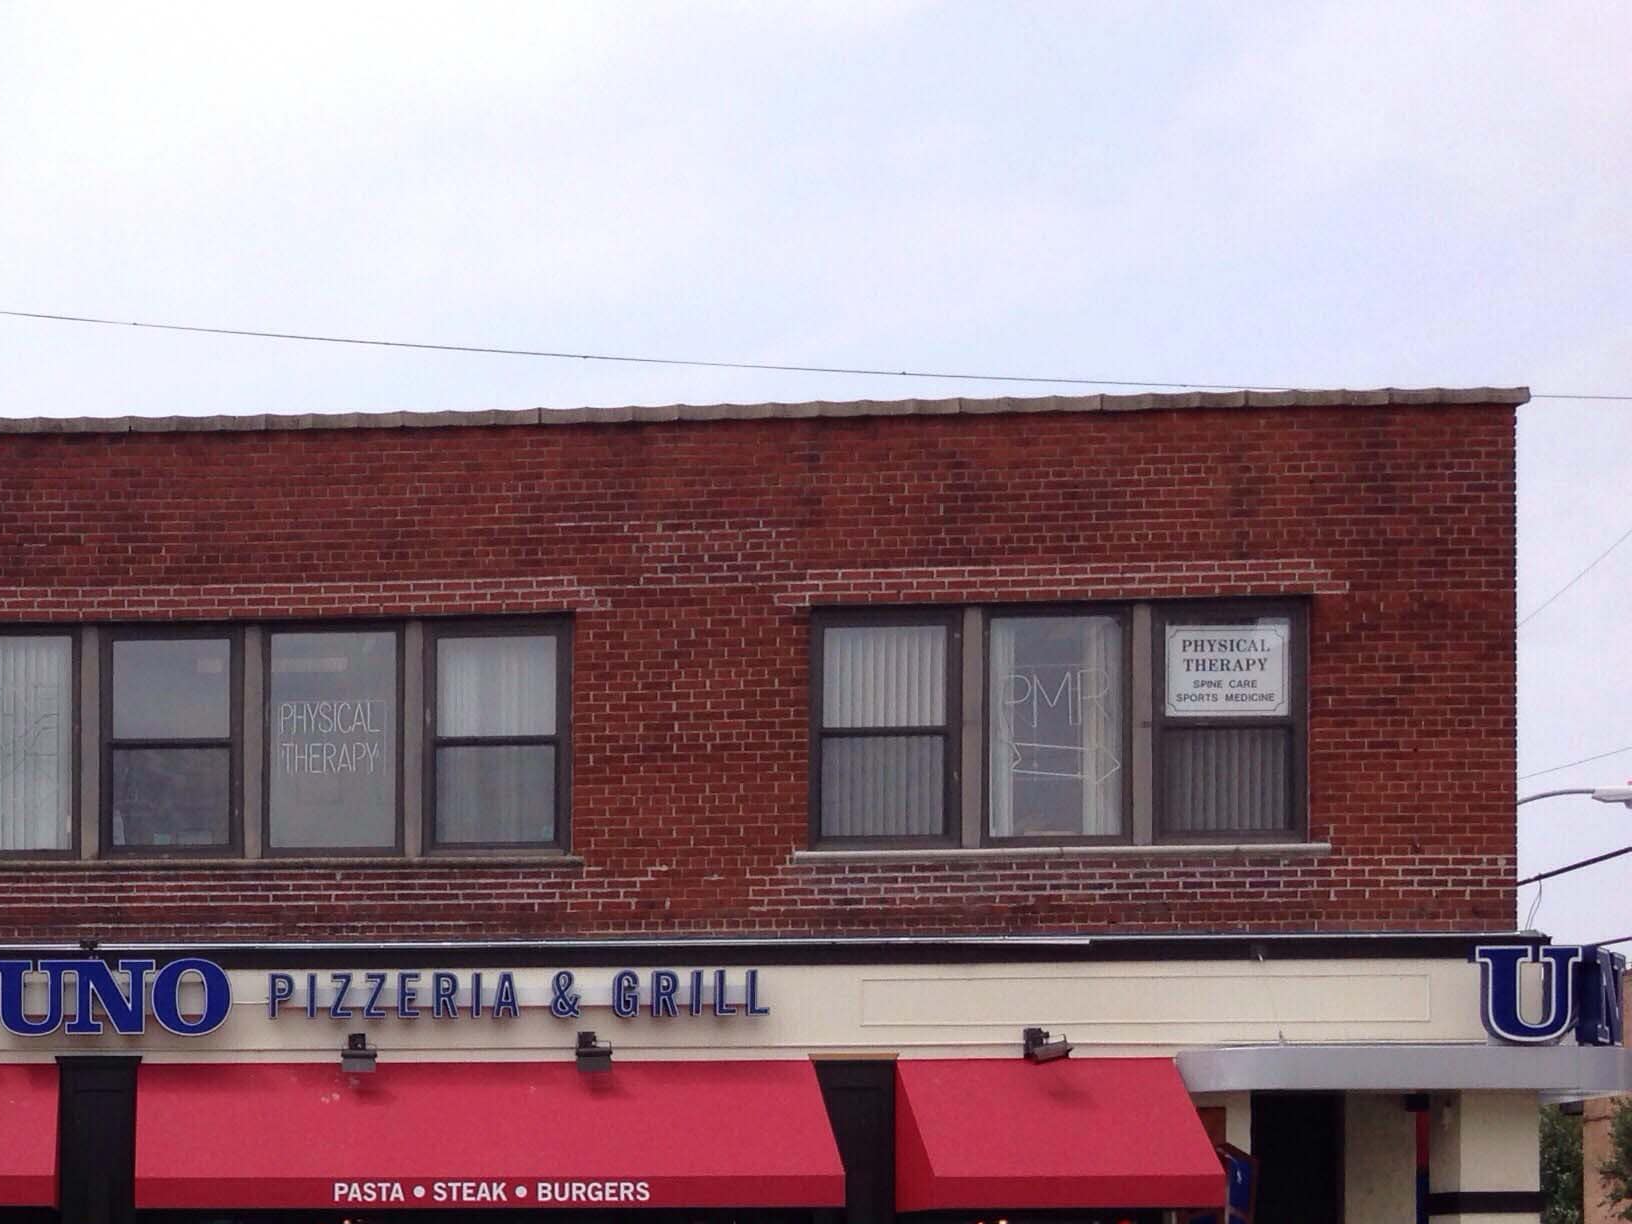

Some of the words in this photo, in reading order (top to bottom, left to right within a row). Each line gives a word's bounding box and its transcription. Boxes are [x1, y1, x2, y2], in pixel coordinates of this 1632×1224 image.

[1182, 639, 1271, 653] PHYSICAL
[1183, 658, 1267, 672] THERAPY
[1193, 680, 1223, 688] SPINE
[1229, 680, 1257, 688] CARE
[1176, 693, 1218, 702] SPORTS
[1225, 693, 1276, 702] MEDICINE
[279, 702, 381, 735] PHYSICAL
[280, 742, 379, 776] THERAPY
[267, 971, 521, 1019] PIZZERIA
[550, 970, 581, 1019] &
[612, 967, 771, 1018] GRILL
[333, 1182, 405, 1202] PASTA
[433, 1182, 507, 1202] STEAK
[536, 1182, 651, 1202] BURGERS
